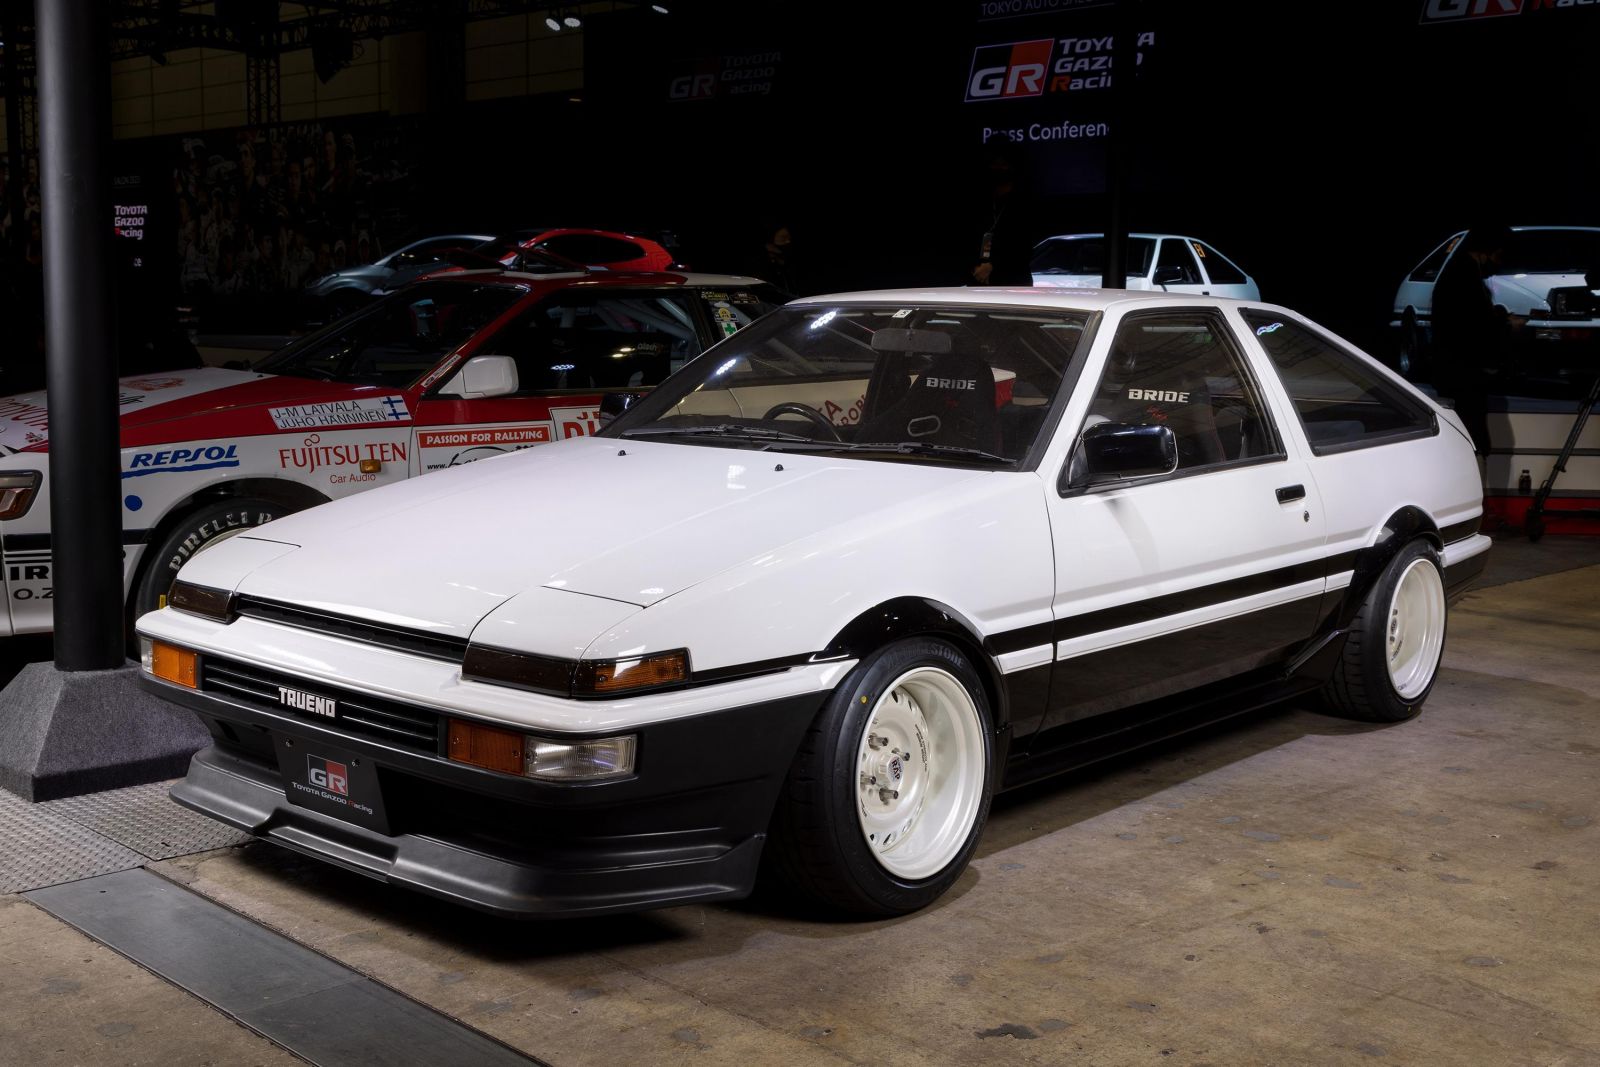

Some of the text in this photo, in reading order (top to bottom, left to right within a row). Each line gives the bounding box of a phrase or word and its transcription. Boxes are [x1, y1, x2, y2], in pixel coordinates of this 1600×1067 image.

[980, 0, 1022, 17] TOKYO
[1058, 31, 1155, 55] TOYA
[723, 51, 782, 67] TOYOTA
[670, 73, 715, 98] GR
[970, 63, 1044, 97] GR
[1050, 72, 1112, 92] Raci
[983, 121, 1109, 144] Pss Conferen
[114, 205, 148, 215] TOYOTA
[114, 216, 145, 227] GAZOO
[926, 377, 977, 390] BRIDE
[1128, 388, 1191, 403] BRIDE
[274, 400, 362, 419] J-M LATVALA
[280, 417, 316, 429] JUHO
[426, 430, 544, 445] PASSION FOR RALLYING
[130, 445, 238, 468] REPSOL
[279, 442, 407, 474] FUJITSU TEN
[329, 473, 377, 484] Car Audio
[168, 511, 249, 571] PIRELLI
[279, 687, 336, 718] TRUENO
[310, 768, 346, 793] GR
[291, 781, 373, 815] TOYOTA GAZOO Racing
